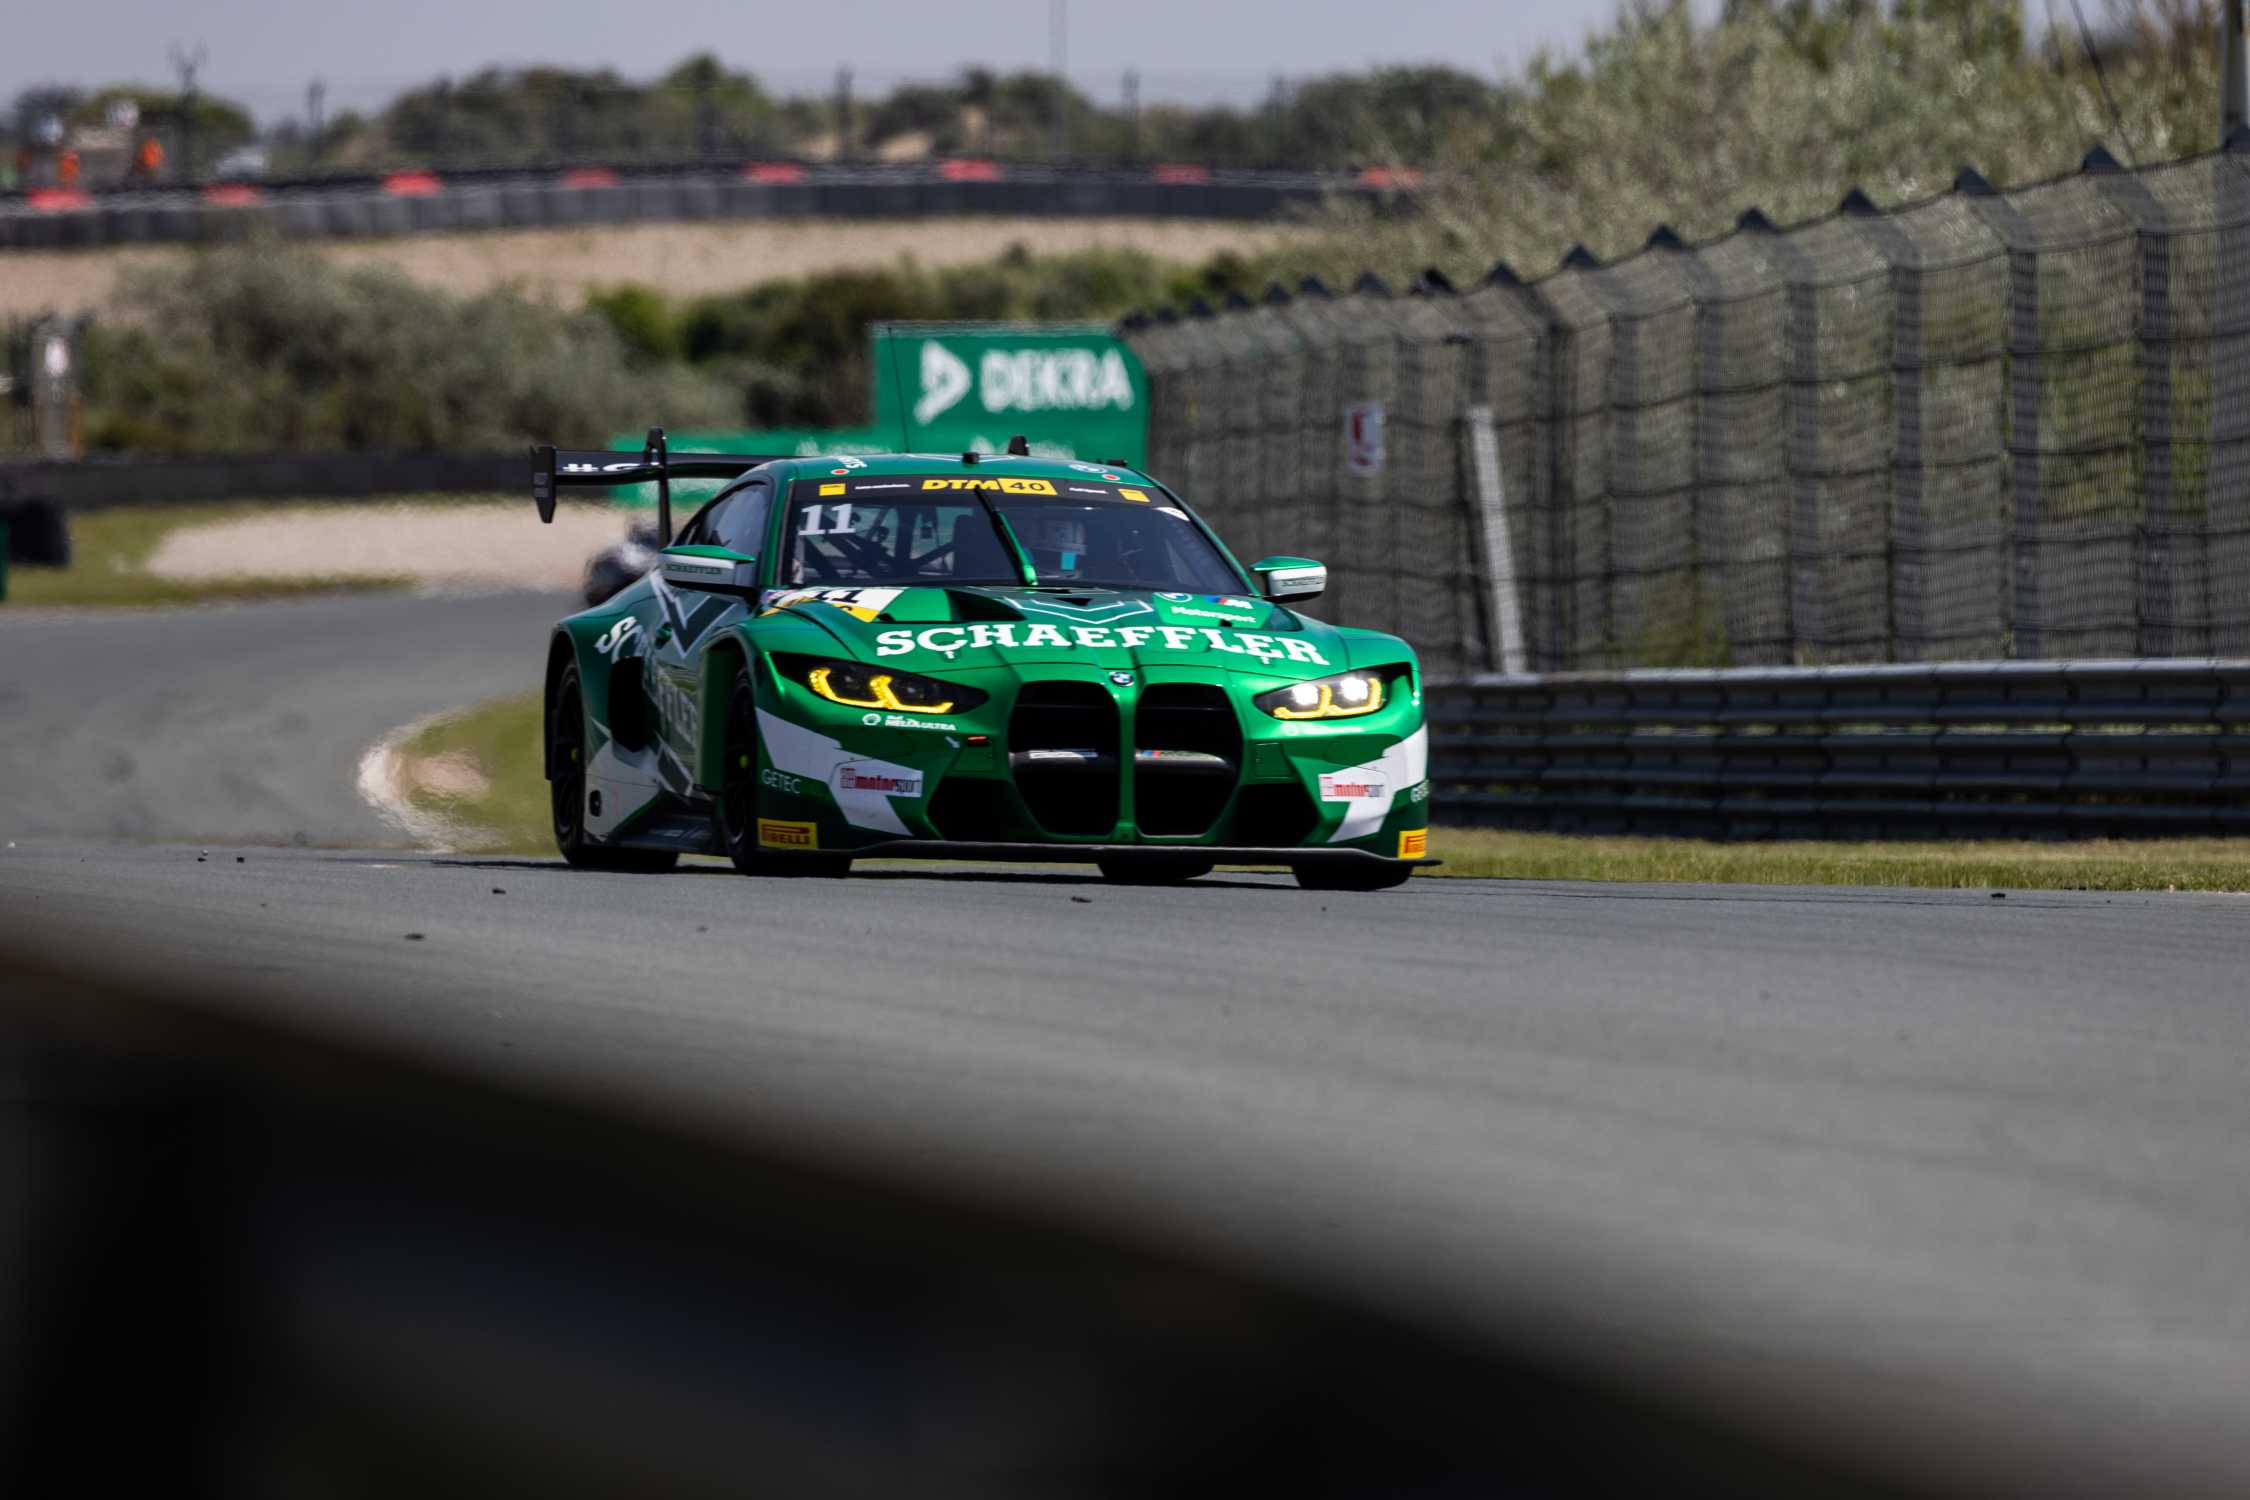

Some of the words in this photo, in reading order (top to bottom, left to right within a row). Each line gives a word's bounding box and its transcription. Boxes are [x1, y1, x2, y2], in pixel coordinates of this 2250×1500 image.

[980, 347, 1134, 412] DEKRA
[921, 479, 1000, 491] DTM
[1009, 481, 1045, 492] 40
[799, 503, 856, 537] 11
[1170, 606, 1257, 623] Motorsport
[876, 623, 1330, 666] SCHAEFFLER
[761, 768, 801, 795] GETEC
[761, 824, 811, 845] PIRELLI
